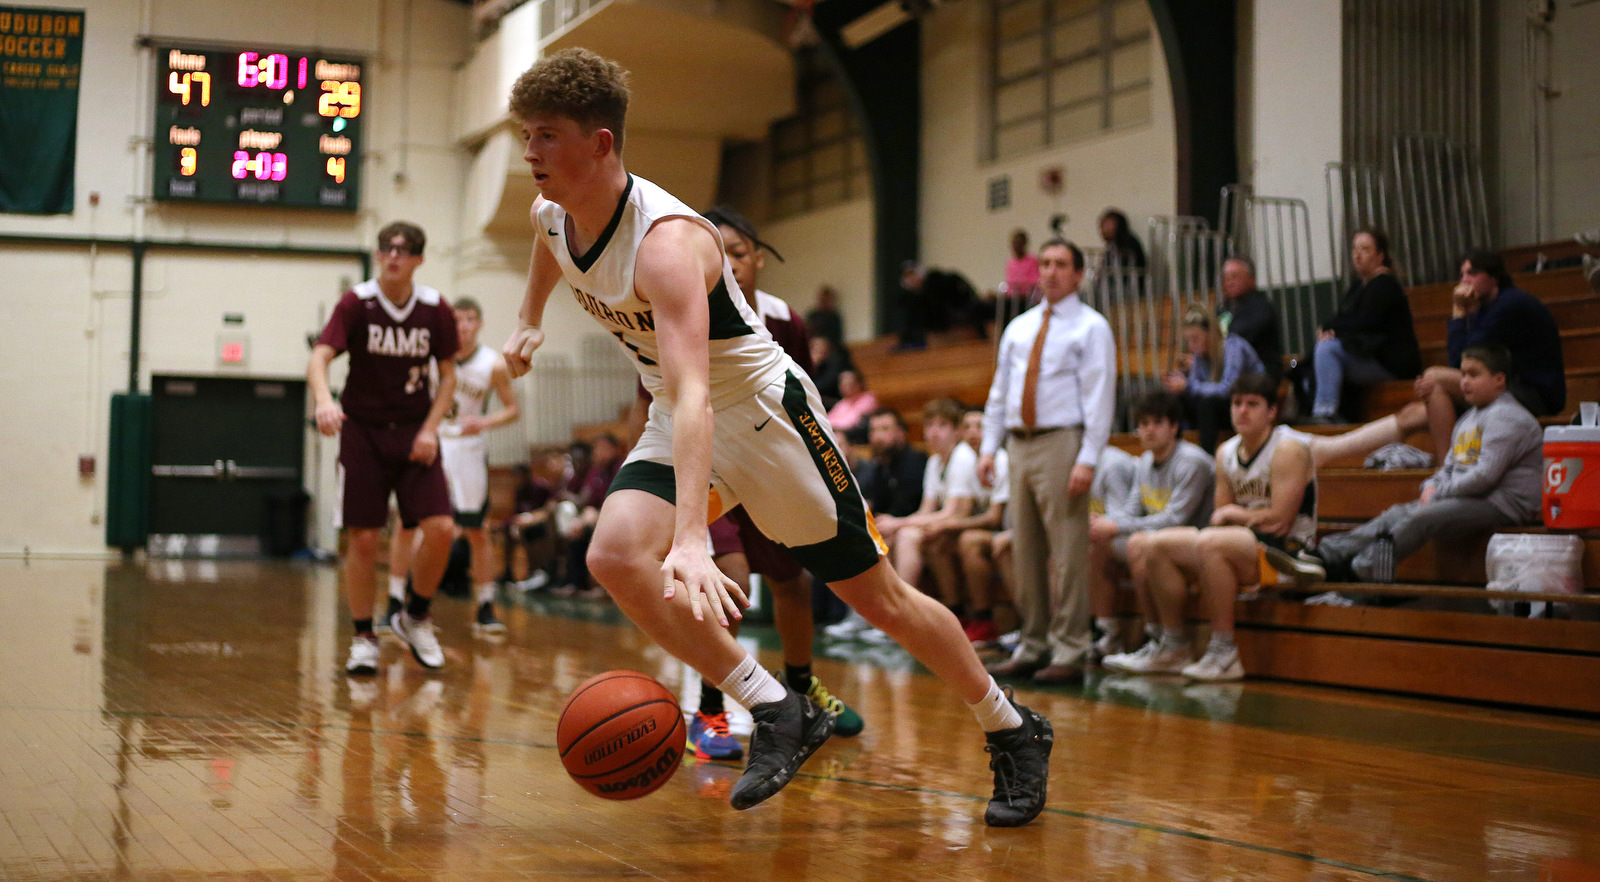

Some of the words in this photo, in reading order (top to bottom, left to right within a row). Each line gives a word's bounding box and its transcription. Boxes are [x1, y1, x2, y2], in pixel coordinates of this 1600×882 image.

[168, 71, 211, 106] 47
[237, 52, 308, 89] 6:01
[318, 80, 361, 118] 29
[180, 147, 197, 176] 3
[326, 156, 346, 184] 4
[367, 323, 431, 358] RAMS
[820, 446, 849, 493] GREEN
[584, 718, 657, 766] EVOLUTION
[597, 746, 678, 793] Wilson
